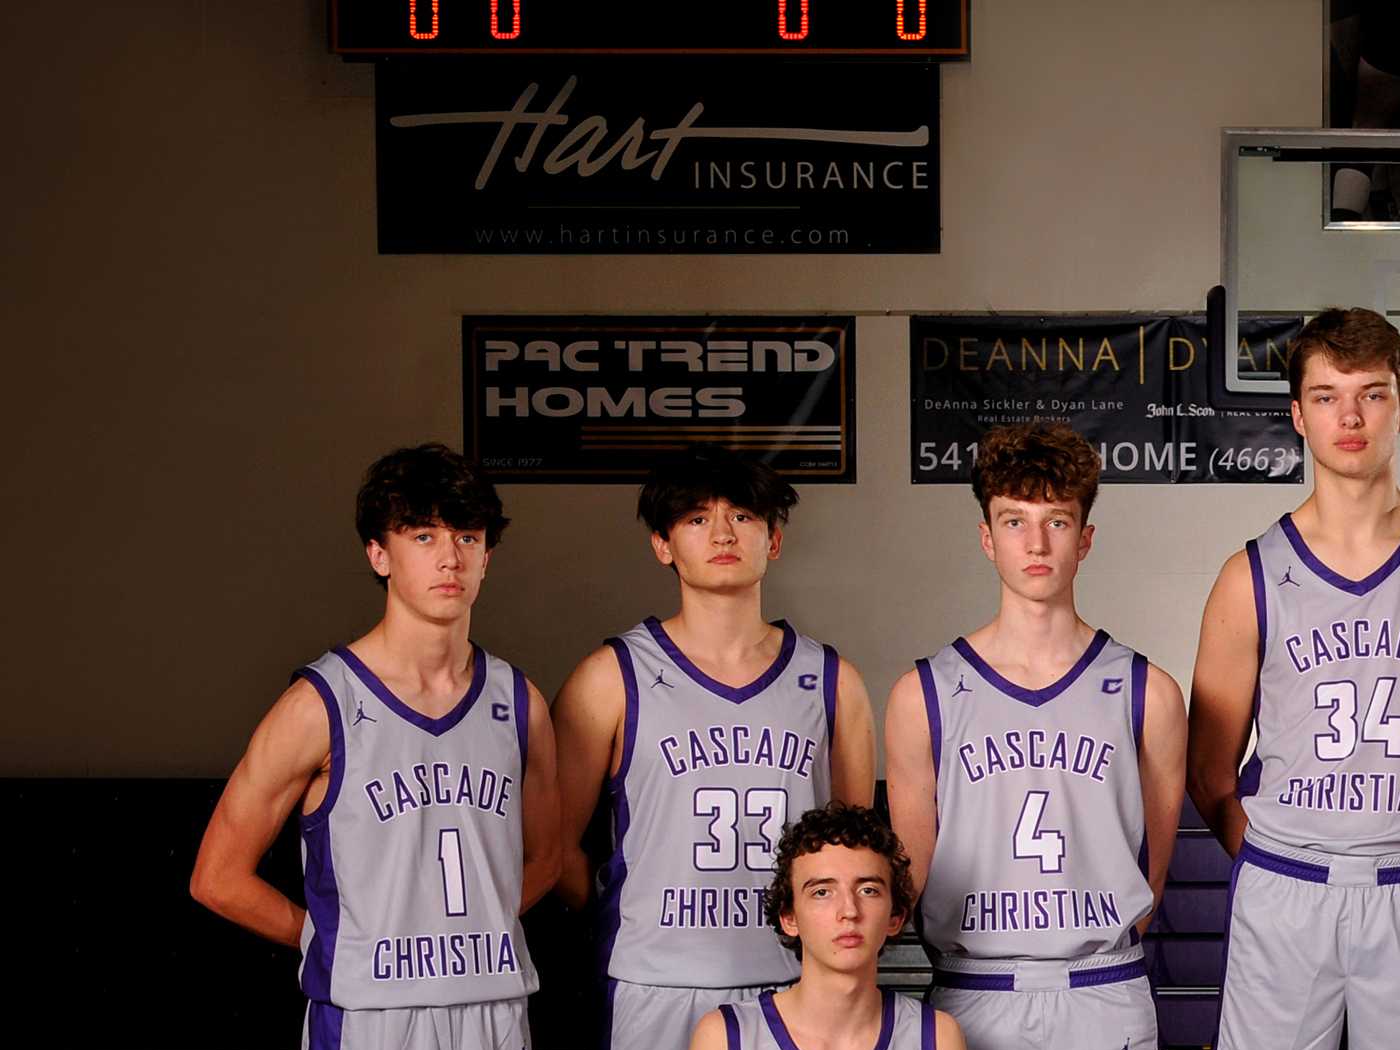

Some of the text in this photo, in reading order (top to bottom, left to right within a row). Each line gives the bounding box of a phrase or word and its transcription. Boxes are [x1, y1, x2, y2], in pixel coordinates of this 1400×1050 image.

[390, 75, 705, 190] Hart
[695, 161, 929, 190] INSURANCE
[475, 224, 849, 245] www.hartinsurance.com
[484, 339, 836, 373] PAC TREND
[923, 336, 1293, 372] DEANNA DAN
[484, 386, 748, 419] HOMES
[924, 400, 1124, 413] DeAnna Sickler & Dyan Lane
[1209, 446, 1298, 477] (4663)
[659, 725, 819, 779] CASCADE
[958, 729, 1115, 783] CASCADE
[364, 761, 516, 823] CASCADE
[693, 787, 789, 872] 33
[1012, 789, 1066, 874] 4
[437, 827, 468, 917] 1
[658, 886, 768, 929] CHRIST
[959, 887, 1123, 933] CHRISTIAN
[372, 930, 518, 981] CHRISTIA
